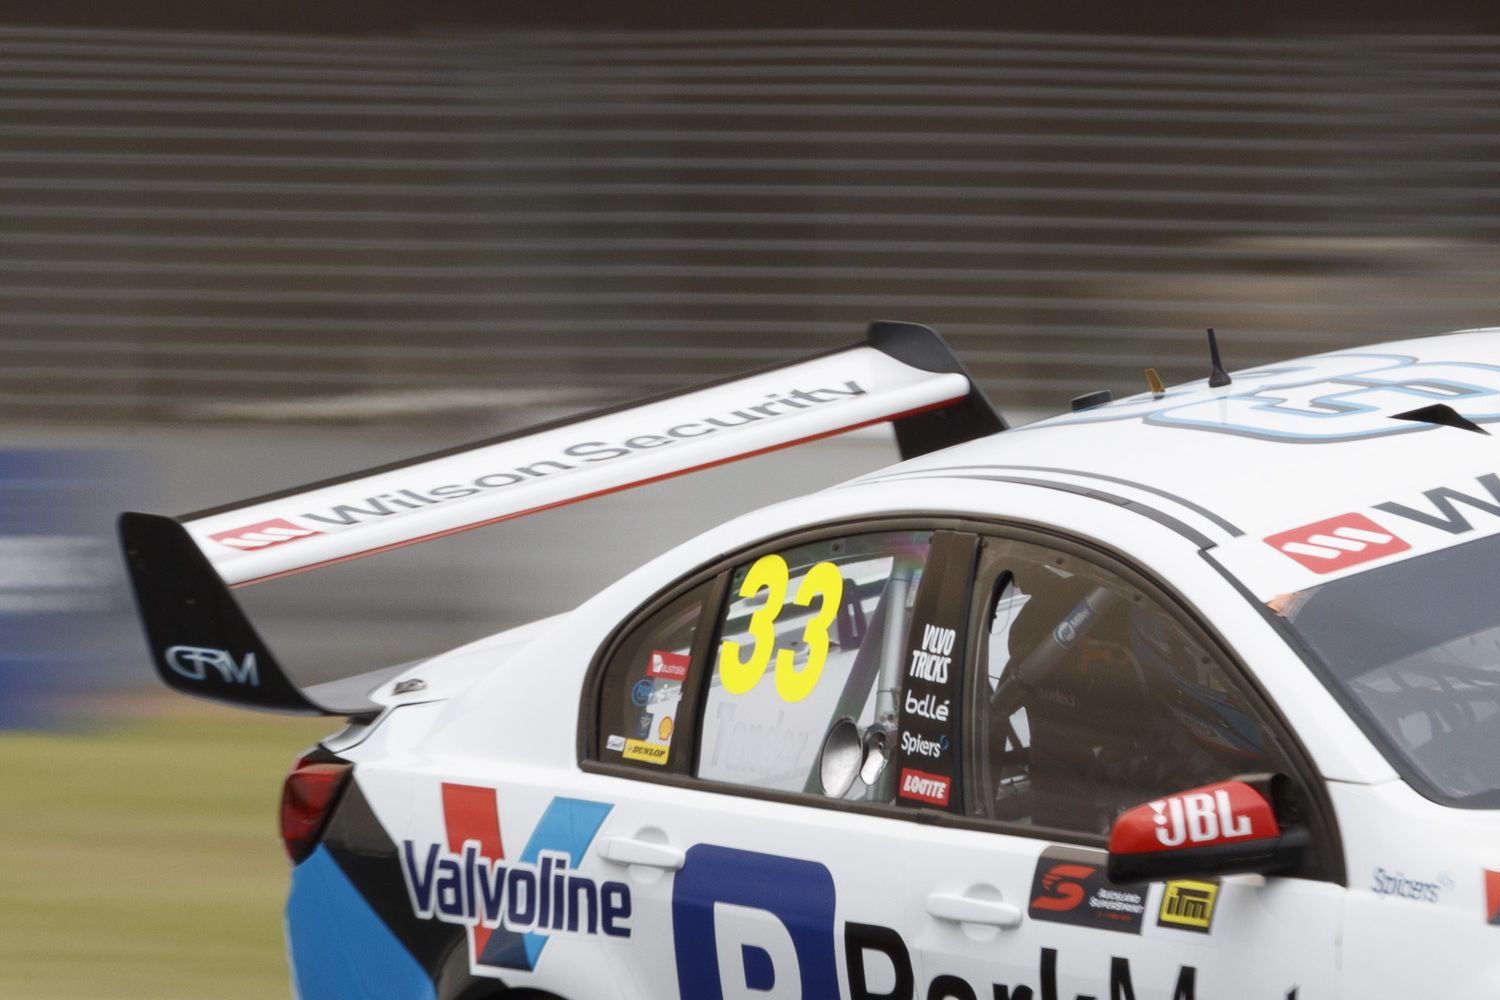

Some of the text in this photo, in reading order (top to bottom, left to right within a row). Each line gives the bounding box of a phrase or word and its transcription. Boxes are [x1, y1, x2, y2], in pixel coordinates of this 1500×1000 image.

[302, 380, 866, 525] Wilson Security
[720, 554, 843, 702] 33
[165, 645, 259, 686] GRM
[632, 745, 665, 757] DUNLOP
[1155, 789, 1252, 846] JBL
[403, 840, 632, 938] Valvoline
[1371, 868, 1441, 903] Spicers
